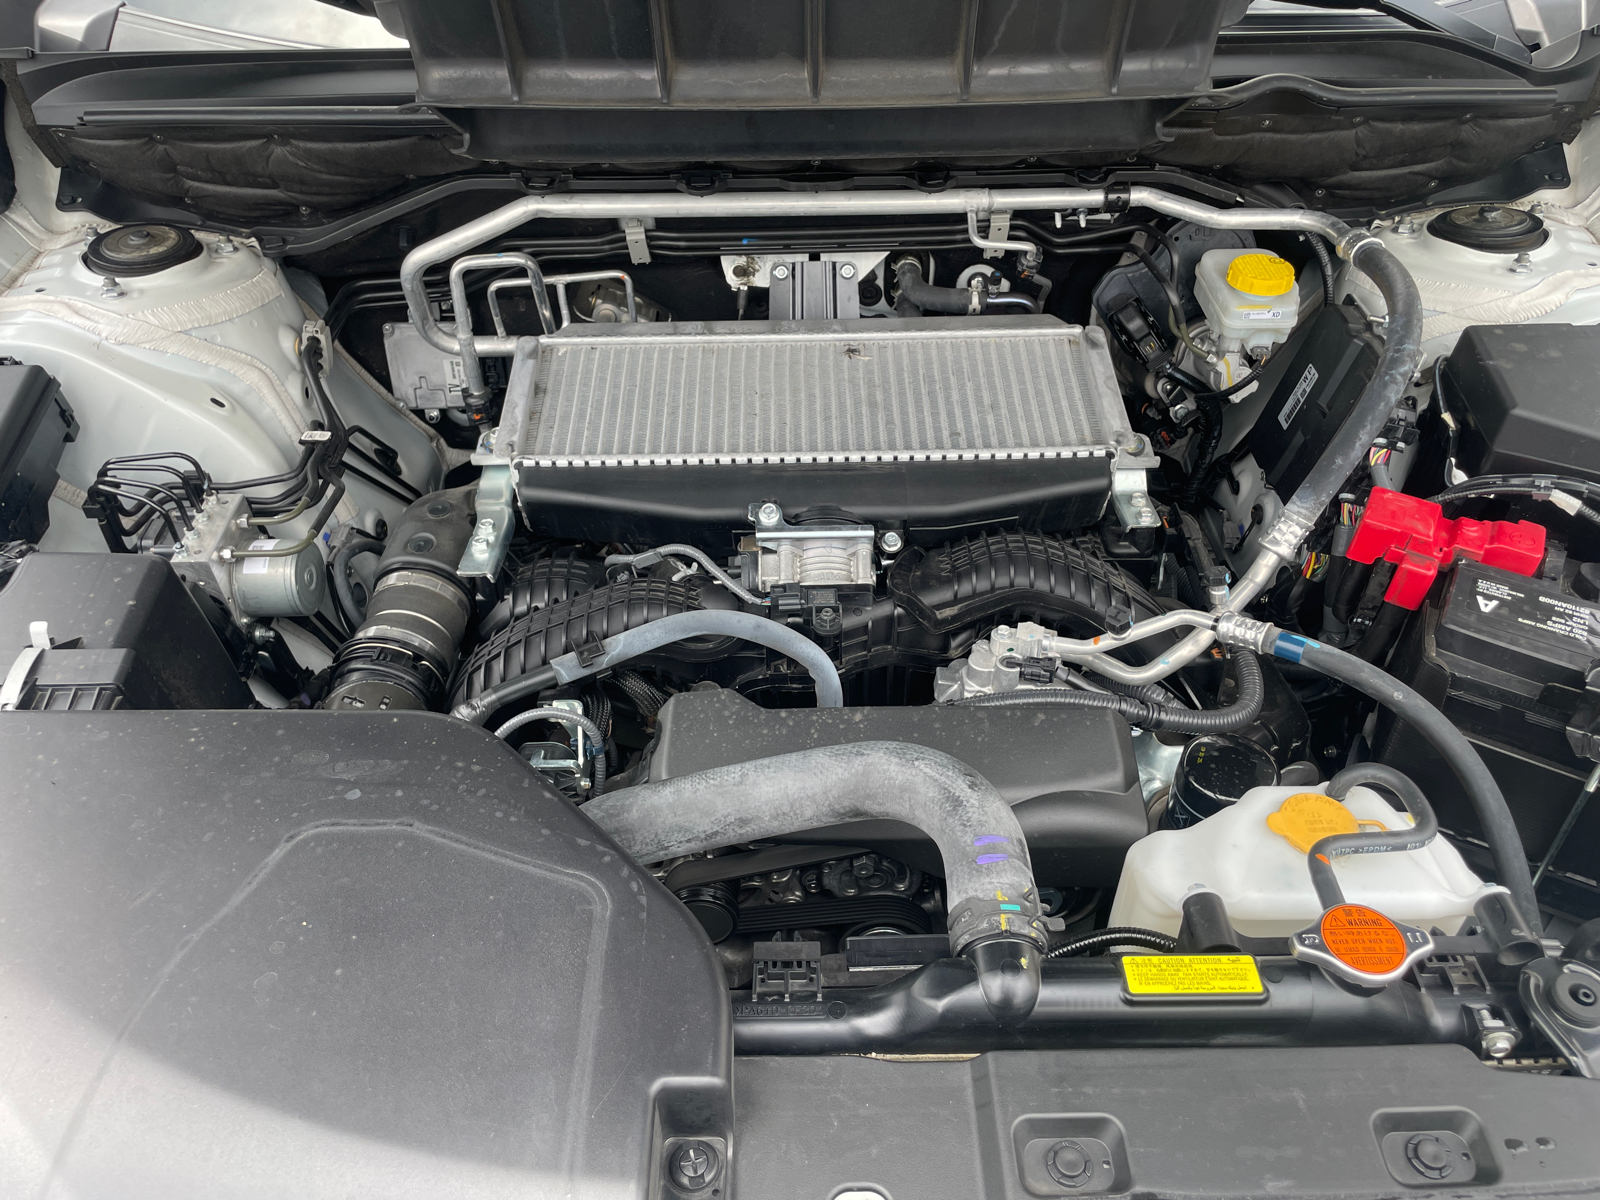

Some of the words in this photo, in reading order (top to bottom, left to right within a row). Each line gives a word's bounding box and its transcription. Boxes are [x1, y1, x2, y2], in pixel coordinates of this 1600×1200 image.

[1518, 618, 1536, 626] AMPS
[1546, 620, 1571, 631] AMPS
[1536, 623, 1569, 636] CRANKING
[1569, 632, 1587, 640] COLD
[1346, 918, 1382, 926] WARNING
